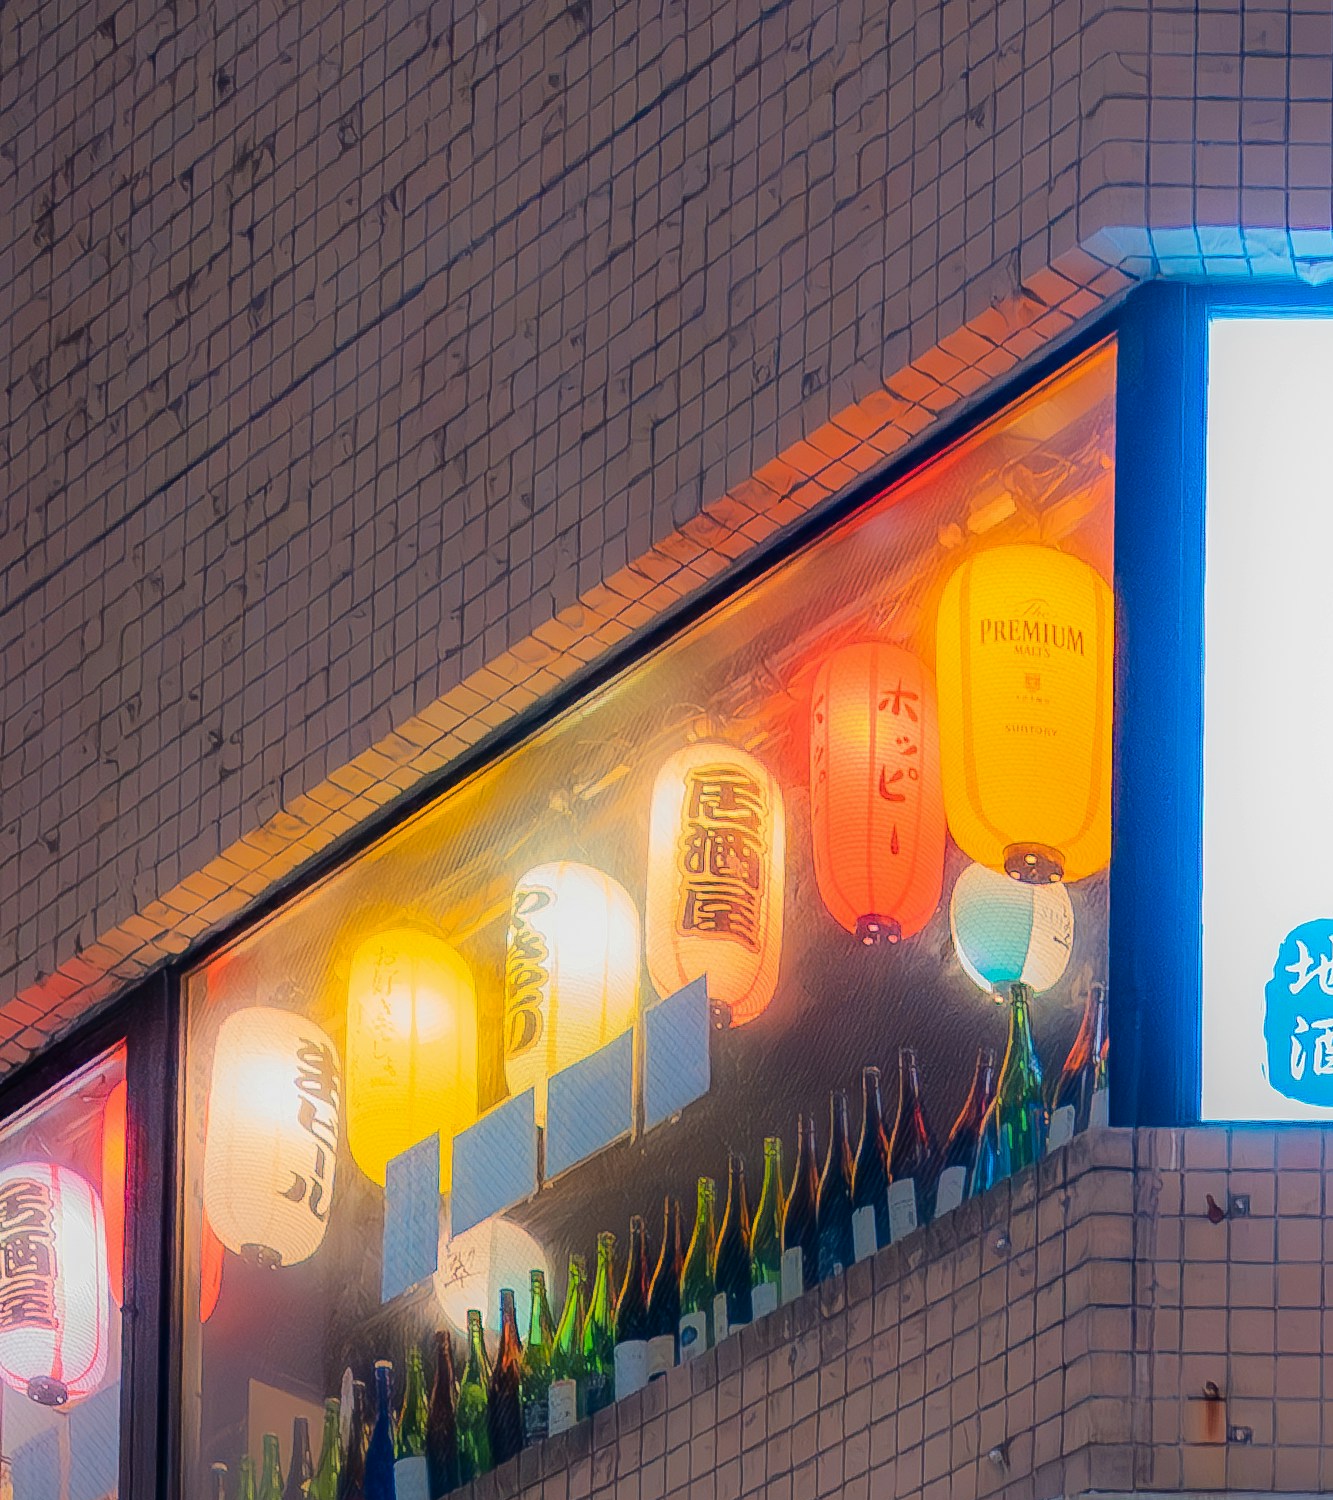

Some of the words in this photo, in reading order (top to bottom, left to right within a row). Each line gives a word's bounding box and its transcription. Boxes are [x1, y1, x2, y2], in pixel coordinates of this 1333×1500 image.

[979, 617, 1086, 657] PREMIUM
[877, 677, 921, 856] ホッピー
